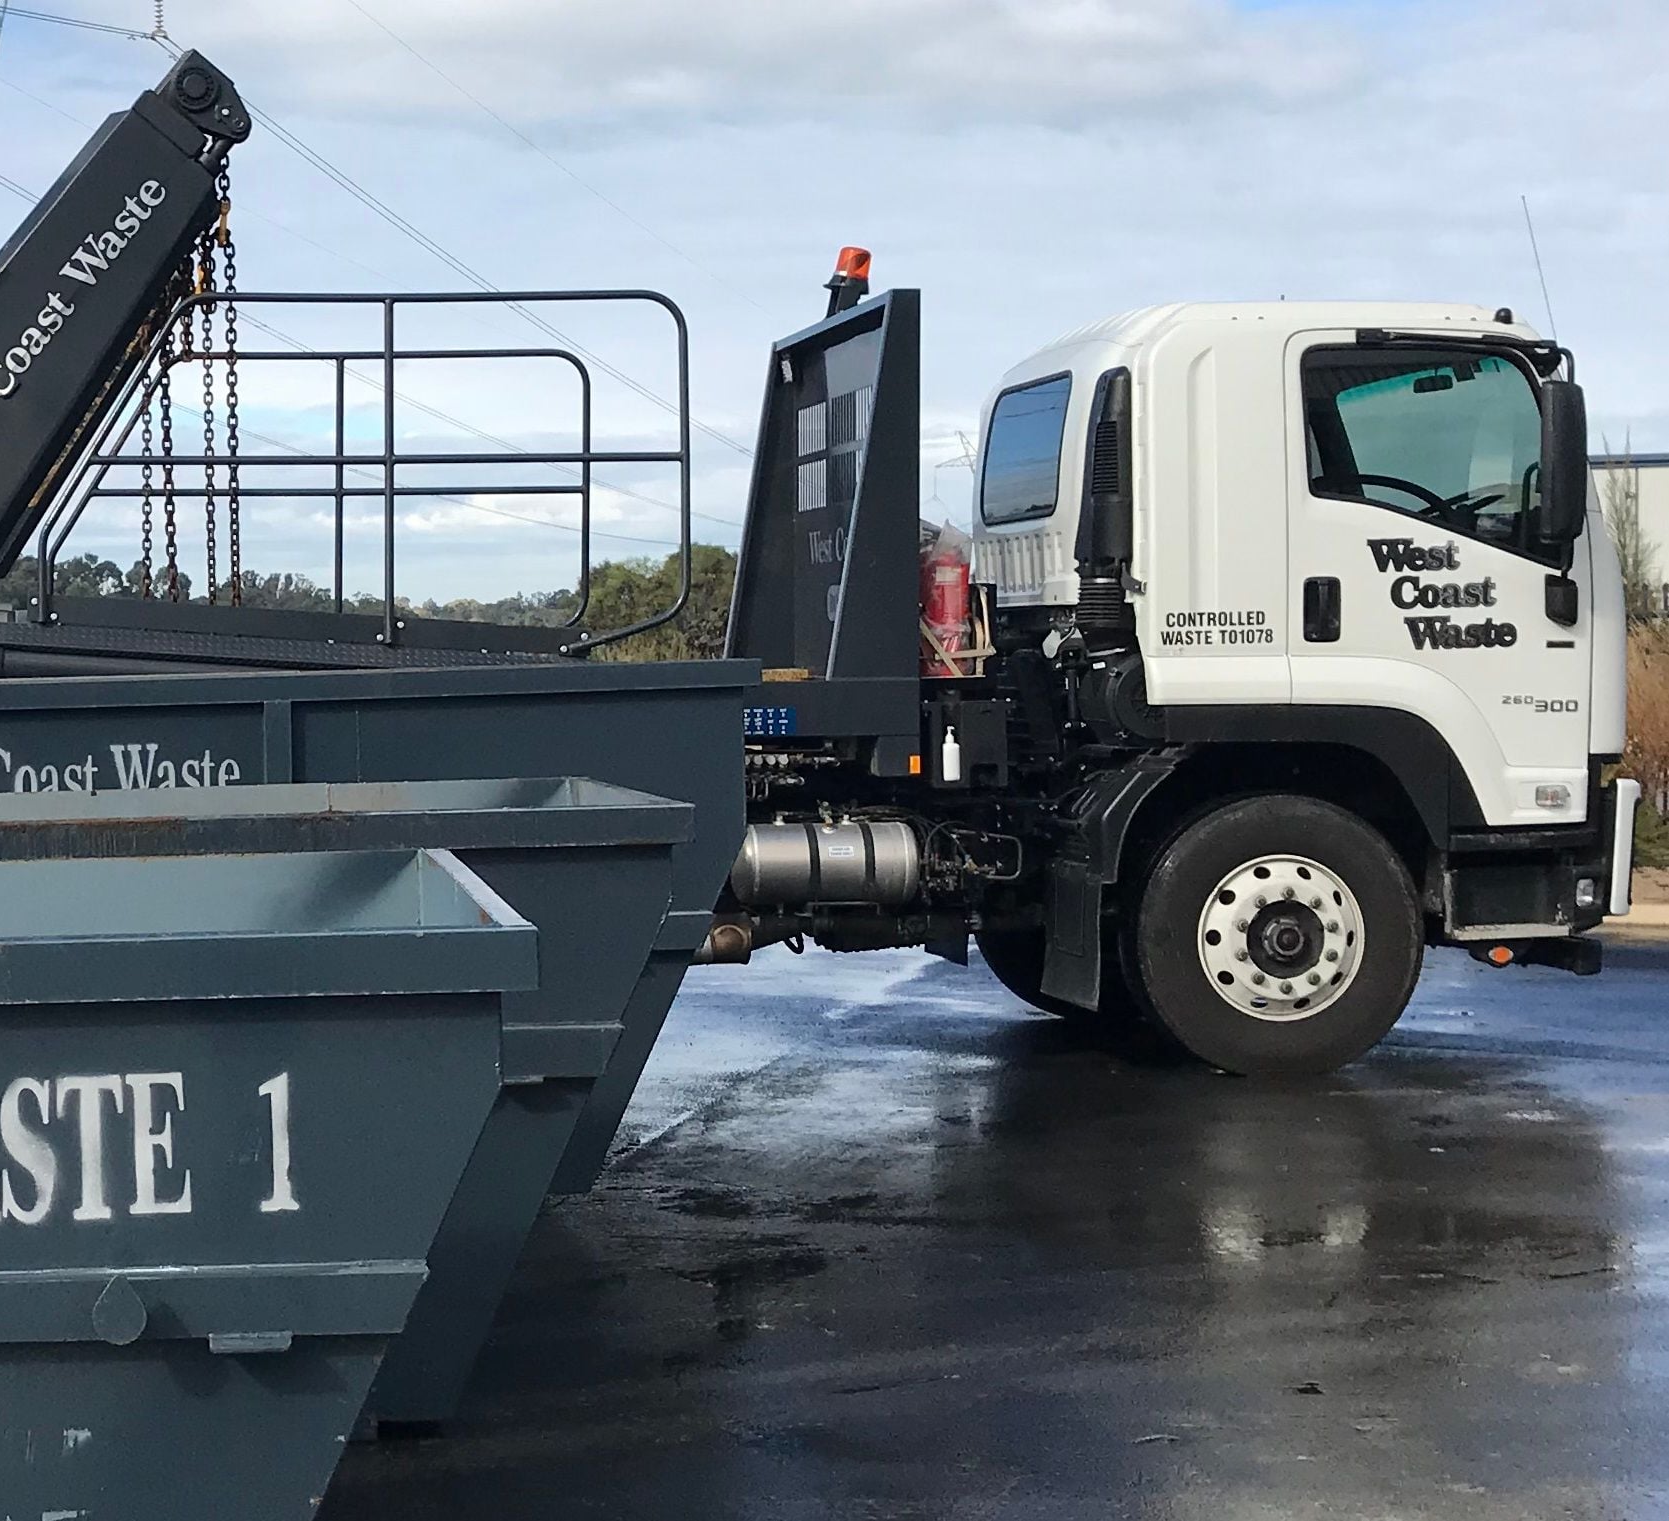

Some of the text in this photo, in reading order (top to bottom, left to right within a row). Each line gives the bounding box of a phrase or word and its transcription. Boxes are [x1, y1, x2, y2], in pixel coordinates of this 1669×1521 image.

[58, 179, 167, 287] Waste
[1367, 538, 1461, 572] West
[1390, 575, 1497, 609] Coast
[1166, 610, 1265, 628] CONTROLLED
[1403, 615, 1517, 650] Waste
[1160, 630, 1213, 645] WASTE
[1501, 695, 1579, 712] 260 300
[109, 742, 241, 791] Waste
[258, 1071, 300, 1212] 1
